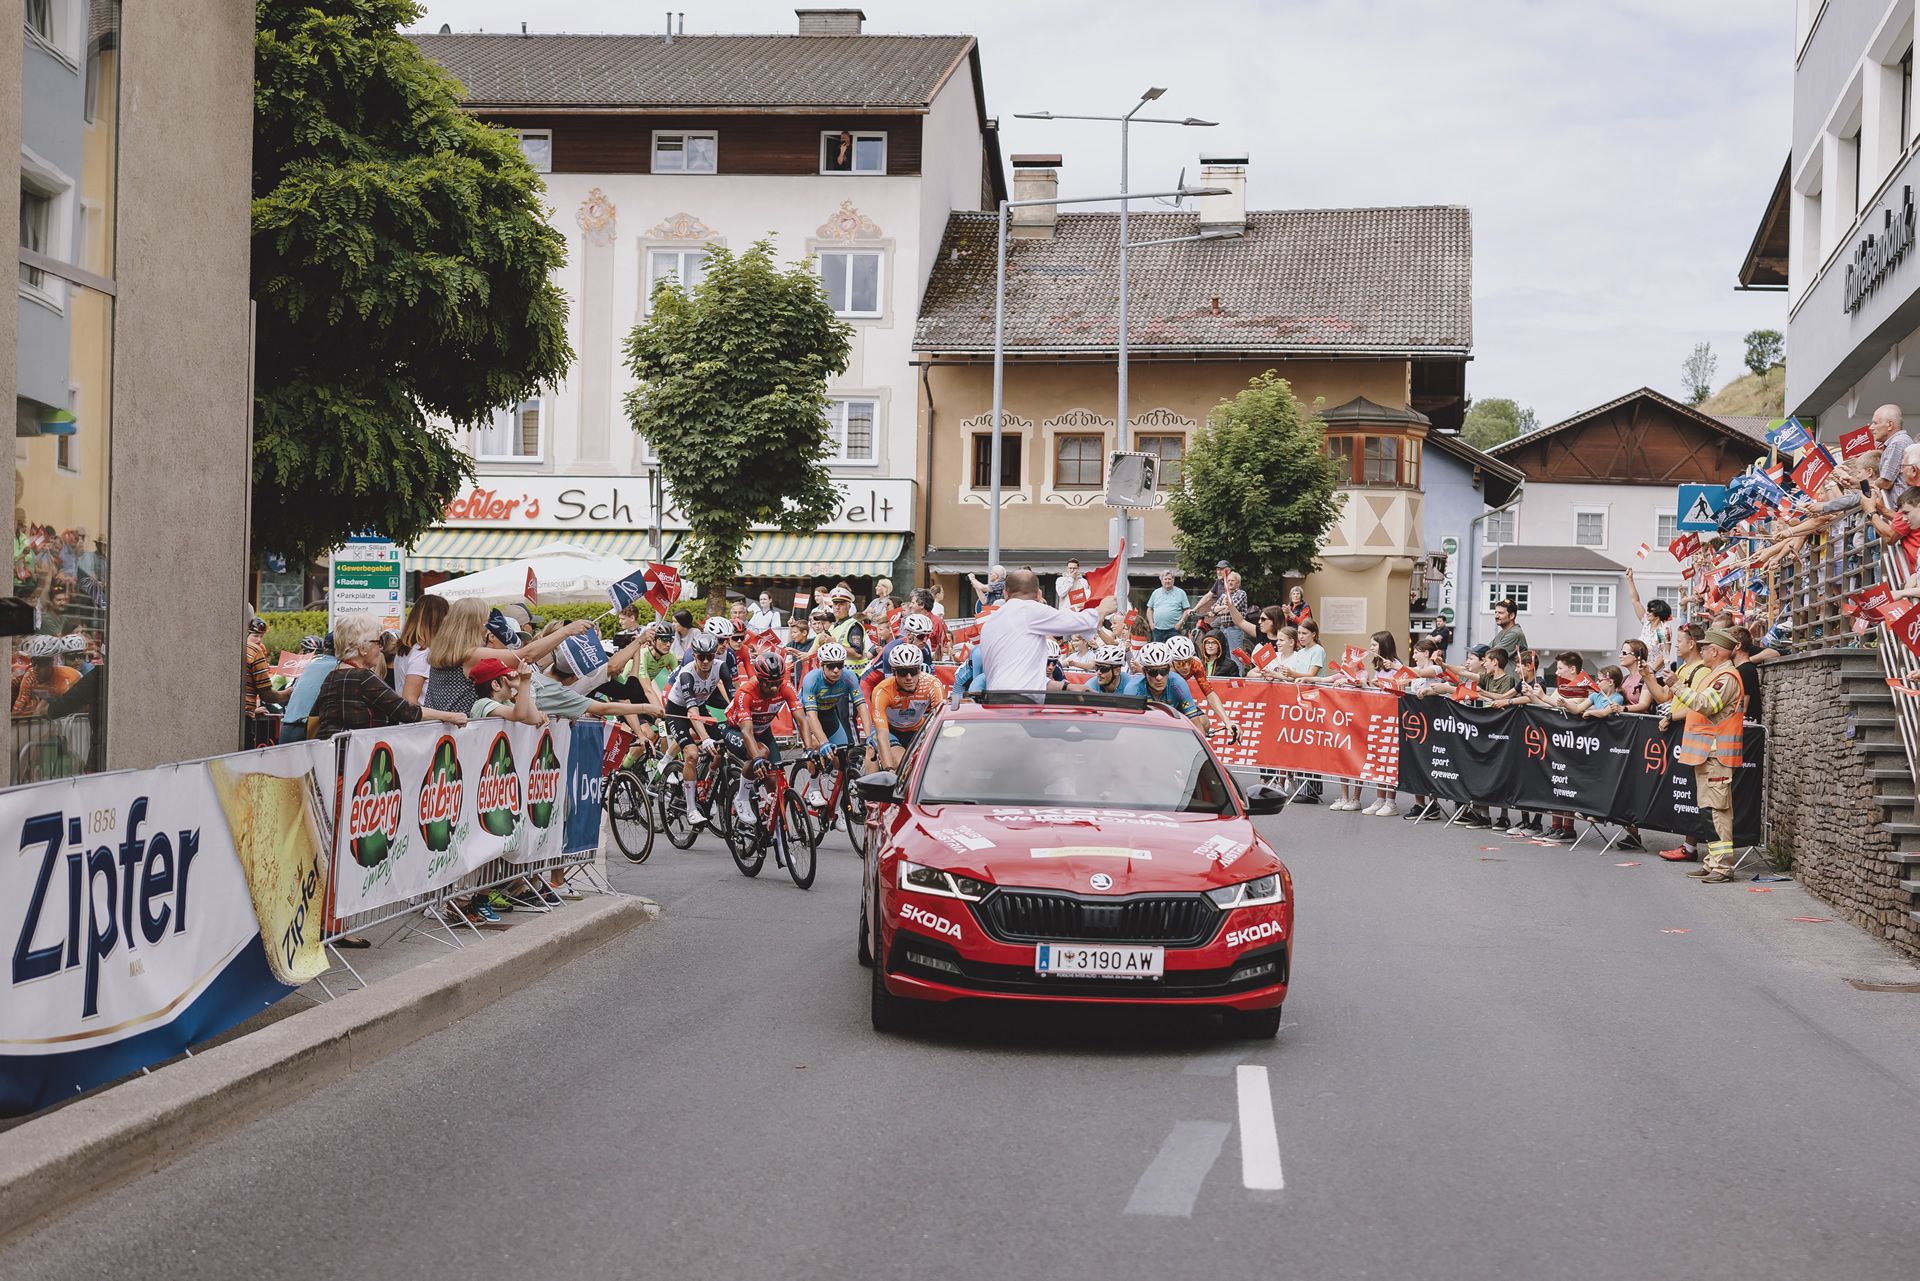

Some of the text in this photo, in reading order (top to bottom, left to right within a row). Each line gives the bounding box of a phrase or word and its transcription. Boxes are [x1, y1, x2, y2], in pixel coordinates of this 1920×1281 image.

[341, 564, 392, 572] Gewerbegebiet
[340, 578, 368, 586] Radweg
[1411, 620, 1433, 629] FE
[1279, 704, 1354, 727] TOUR OF
[1433, 715, 1456, 733] evil
[1277, 727, 1352, 750] AUSTRIA
[1551, 730, 1574, 749] evil
[1432, 745, 1446, 754] true
[1431, 757, 1450, 767] sport
[1551, 761, 1566, 771] true
[1431, 769, 1459, 780] eyewear
[1551, 774, 1568, 784] sport
[1672, 775, 1687, 785] true
[478, 761, 520, 815] eisberg
[1553, 787, 1577, 798] eyewear
[418, 768, 463, 826] eisberg
[1672, 789, 1691, 799] sport
[350, 778, 402, 840] eisberg
[1673, 803, 1699, 814] eyewea
[87, 807, 116, 834] 1858
[12, 796, 200, 1019] Zipfer
[282, 853, 320, 970] Zipfer
[1077, 950, 1121, 969] 3190
[1126, 952, 1153, 970] AW
